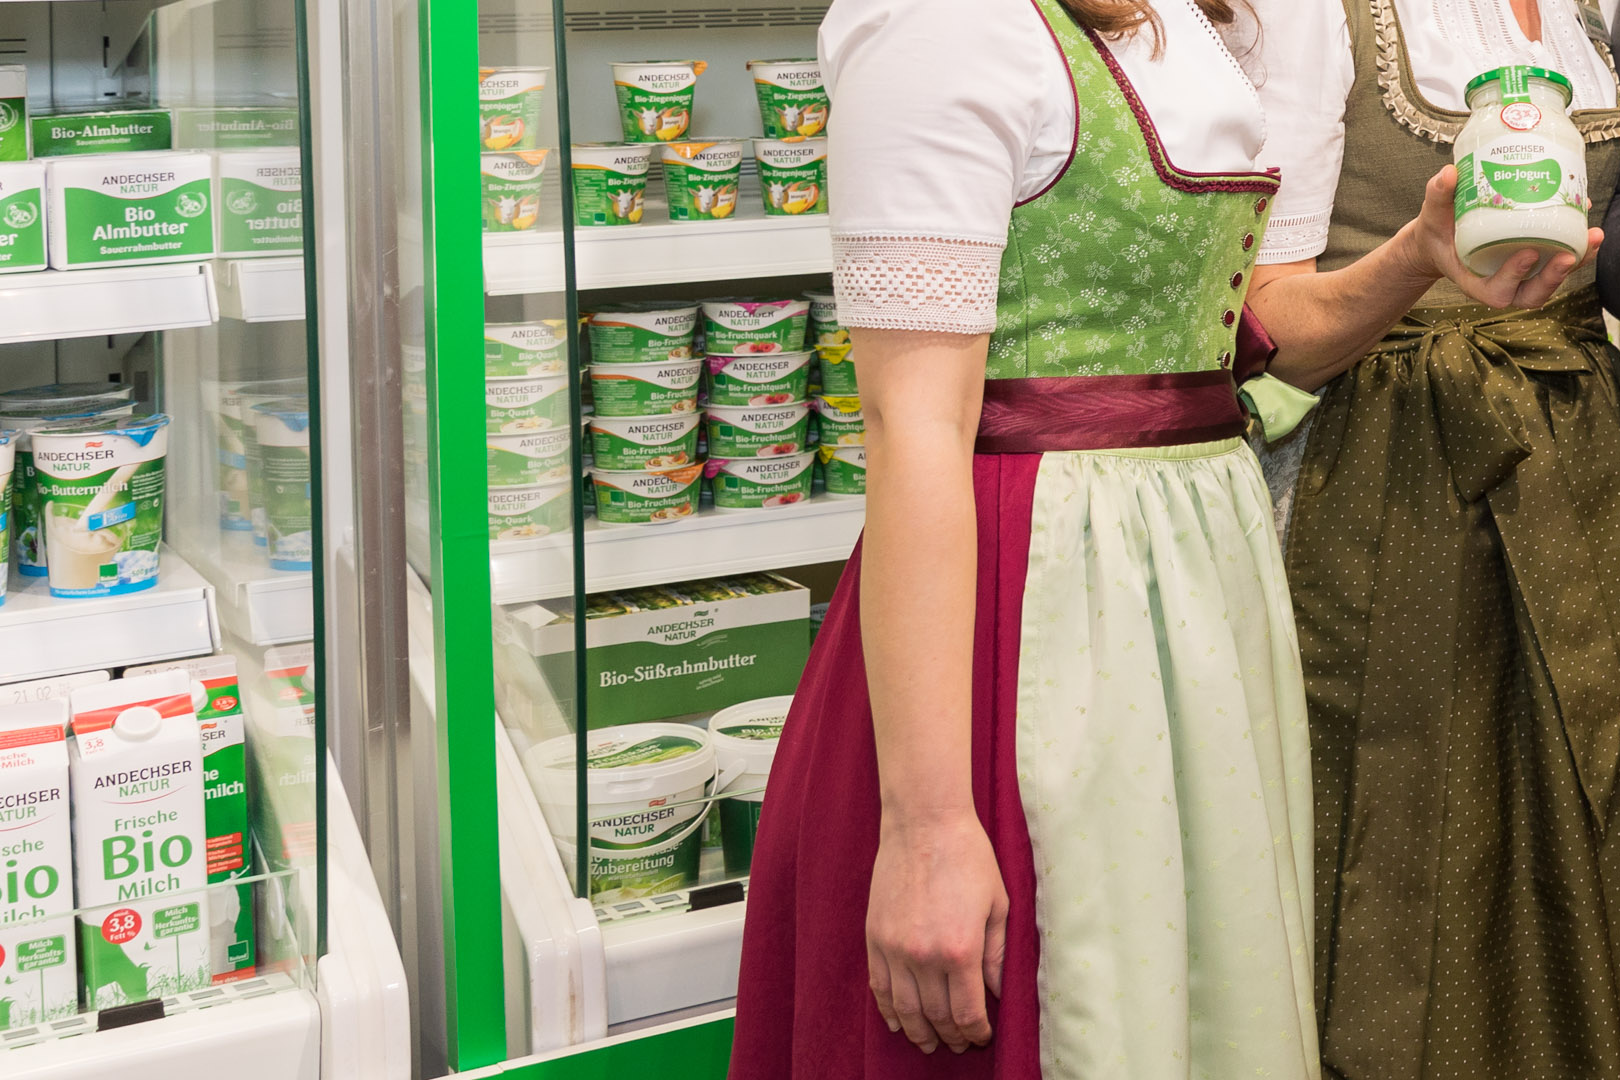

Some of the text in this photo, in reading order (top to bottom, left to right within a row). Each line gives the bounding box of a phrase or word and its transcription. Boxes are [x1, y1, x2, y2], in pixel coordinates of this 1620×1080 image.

[638, 73, 690, 82] ANDECHSER
[634, 94, 691, 104] Bio-Ziegenjogurt
[52, 124, 153, 139] Bio-Almbutter
[763, 149, 814, 157] ANDECHSER
[1490, 145, 1545, 156] ANDECHSER
[773, 156, 801, 164] NATUR
[1503, 153, 1533, 161] NATUR
[102, 172, 175, 186] ANDECHSER
[1494, 169, 1550, 182] Bio-Jogurt
[120, 184, 159, 194] NATUR
[125, 207, 155, 222] Bio
[93, 222, 188, 241] Almbutter
[100, 241, 182, 255] Sauerrahmbutter
[668, 324, 690, 332] NATUR
[730, 318, 760, 326] NATUR
[715, 330, 777, 341] Bio-Fruchtquark
[733, 361, 789, 371] ANDECHSER
[746, 370, 776, 378] NATUR
[671, 376, 694, 385] NATUR
[728, 383, 791, 393] Bio-Fruchtquark
[496, 395, 529, 404] NATUR
[491, 408, 535, 419] Bio-Quark
[741, 411, 796, 422] ANDECHSER
[628, 422, 684, 434] ANDECHSER
[754, 420, 784, 429] NATUR
[642, 432, 673, 441] NATUR
[735, 431, 797, 443] Bio-Fruchtquark
[623, 443, 686, 455] Bio-Fruchtquark
[38, 449, 115, 462] ANDECHSER
[53, 462, 91, 472] NATUR
[746, 461, 801, 474] ANDECHSER
[760, 471, 789, 480] NATUR
[633, 477, 676, 488] ANDECH
[741, 482, 802, 495] Bio-Fruchtquark
[37, 482, 128, 496] io-Buttermilch
[647, 484, 678, 494] NATUR
[494, 502, 526, 511] NATUR
[628, 495, 690, 508] Bio-Fruchtquark
[647, 618, 715, 636] ANDECHSER
[664, 630, 697, 642] NATUR
[600, 653, 757, 688] Bio-Süßrahmbutter
[94, 761, 192, 789] ANDECHSER
[119, 779, 170, 798] NATUR
[0, 788, 60, 809] ECHSER
[115, 810, 178, 832] Frische
[592, 808, 675, 828] ANDECHSER
[615, 824, 655, 837] NATUR
[1, 839, 45, 856] sche
[102, 830, 193, 880] Bio
[591, 855, 675, 875] Zubereitung
[0, 860, 59, 903] io
[118, 873, 180, 901] Milch
[165, 906, 188, 918] Milch
[109, 914, 135, 932] 3,8
[155, 917, 198, 930] Herkunfts-
[160, 923, 194, 936] garantie
[110, 931, 126, 941] Fett
[28, 940, 53, 951] Milch
[18, 949, 64, 963] Herkunfts-
[24, 956, 60, 970] garantie
